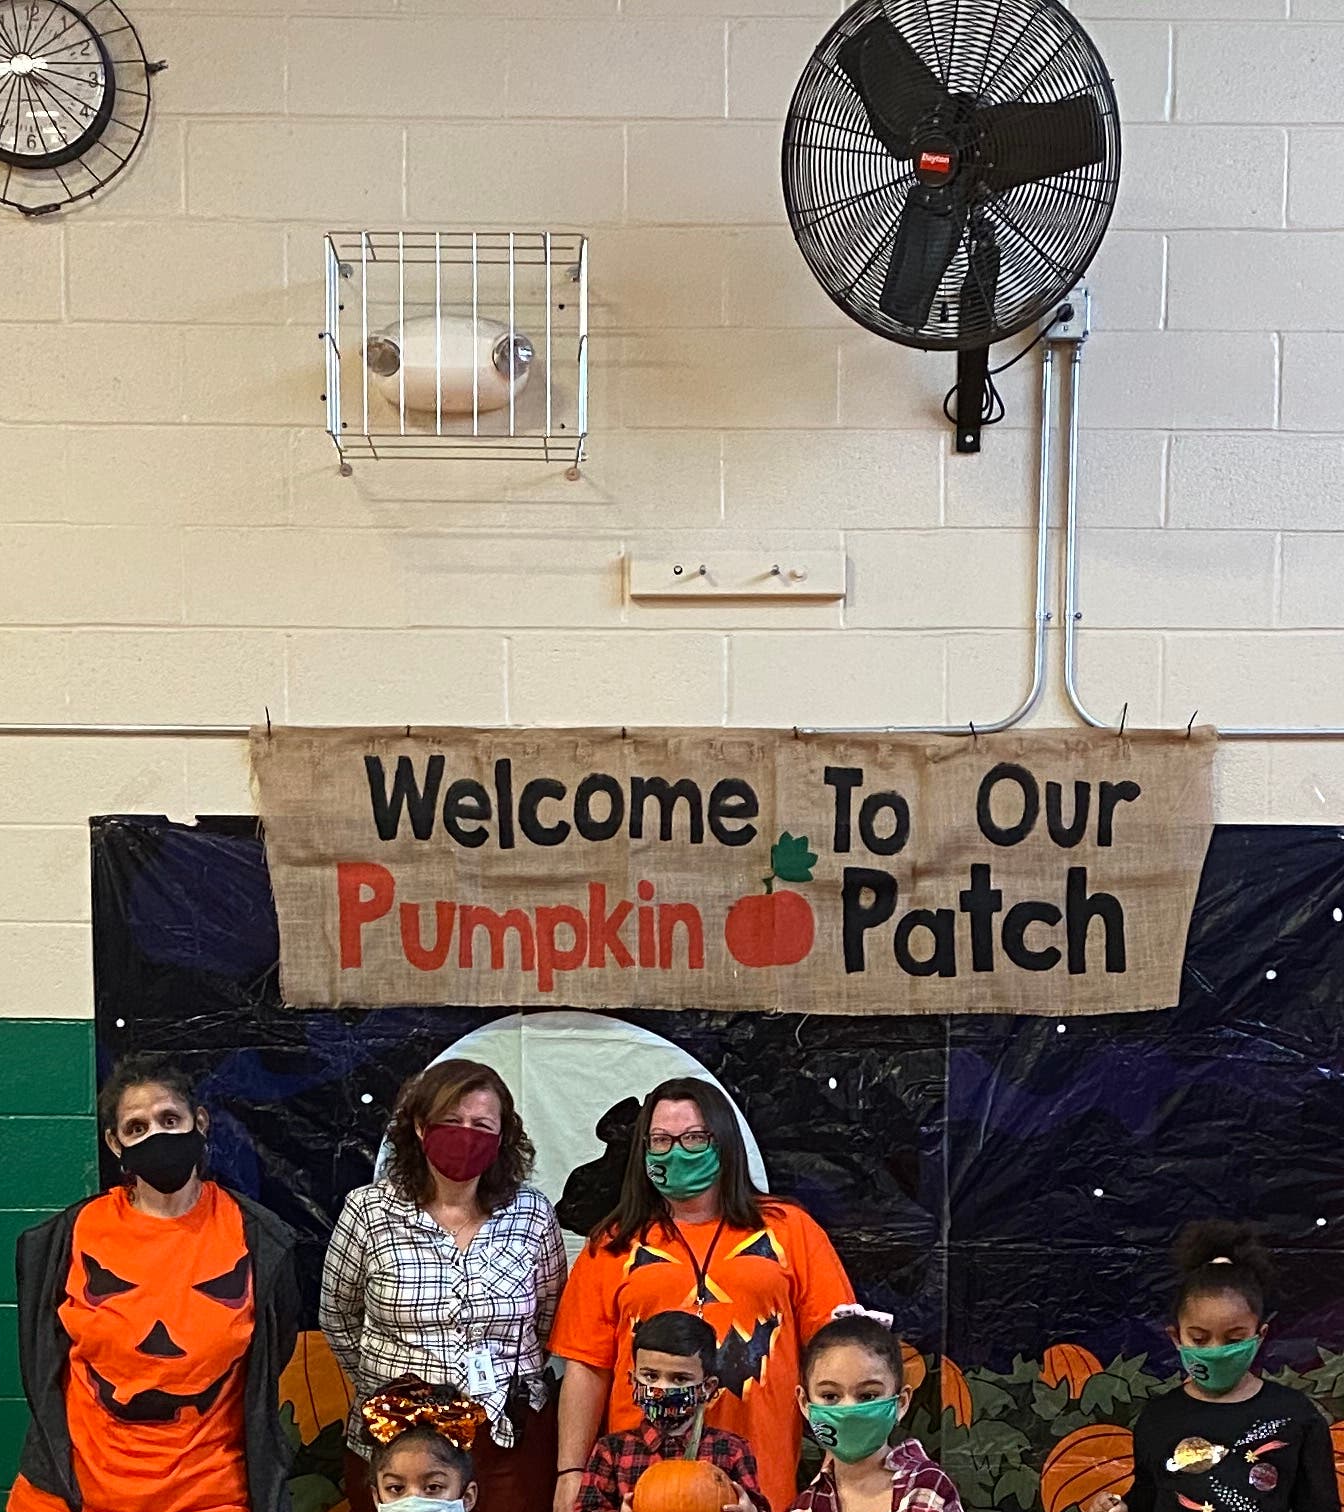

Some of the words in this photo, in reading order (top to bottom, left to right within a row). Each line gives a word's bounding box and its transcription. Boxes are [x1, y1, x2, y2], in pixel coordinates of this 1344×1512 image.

[25, 6, 39, 21] 12
[81, 41, 90, 56] 2
[89, 72, 98, 88] 3
[80, 106, 90, 119] 4
[27, 134, 37, 150] 6
[364, 754, 759, 850] Welcome
[824, 765, 910, 857] To
[976, 761, 1141, 849] Our
[337, 861, 705, 993] Pumpkin
[841, 865, 1126, 978] Patch
